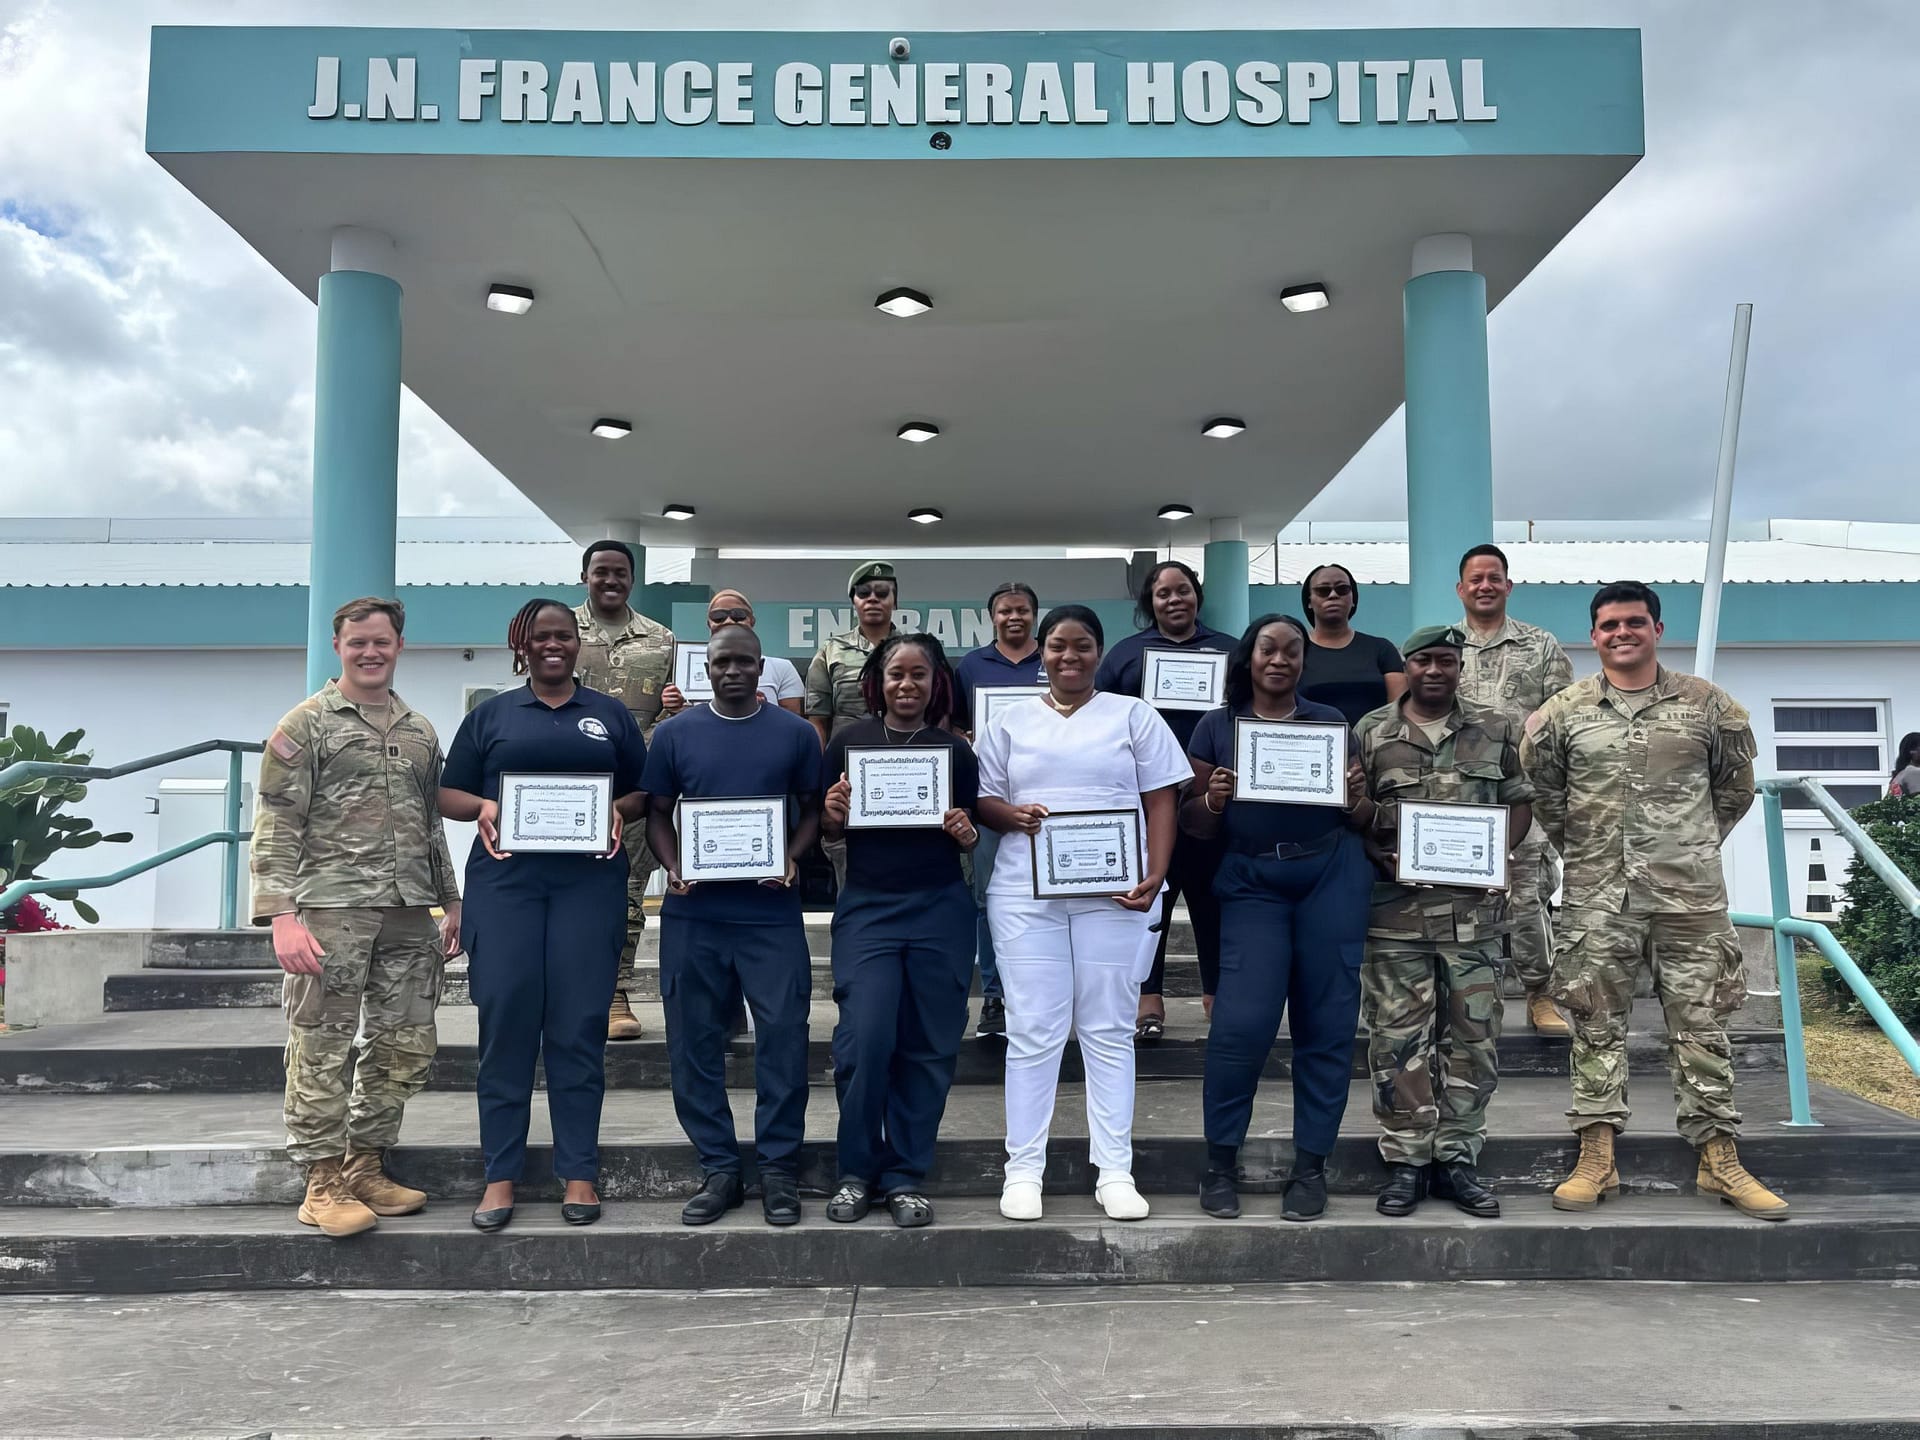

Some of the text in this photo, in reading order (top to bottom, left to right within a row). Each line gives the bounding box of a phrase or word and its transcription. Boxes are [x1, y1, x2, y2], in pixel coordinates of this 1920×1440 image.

[308, 56, 1498, 126] J.N. FRANCE GENERAL HOSPITAL
[788, 607, 1053, 648] ENRAN
